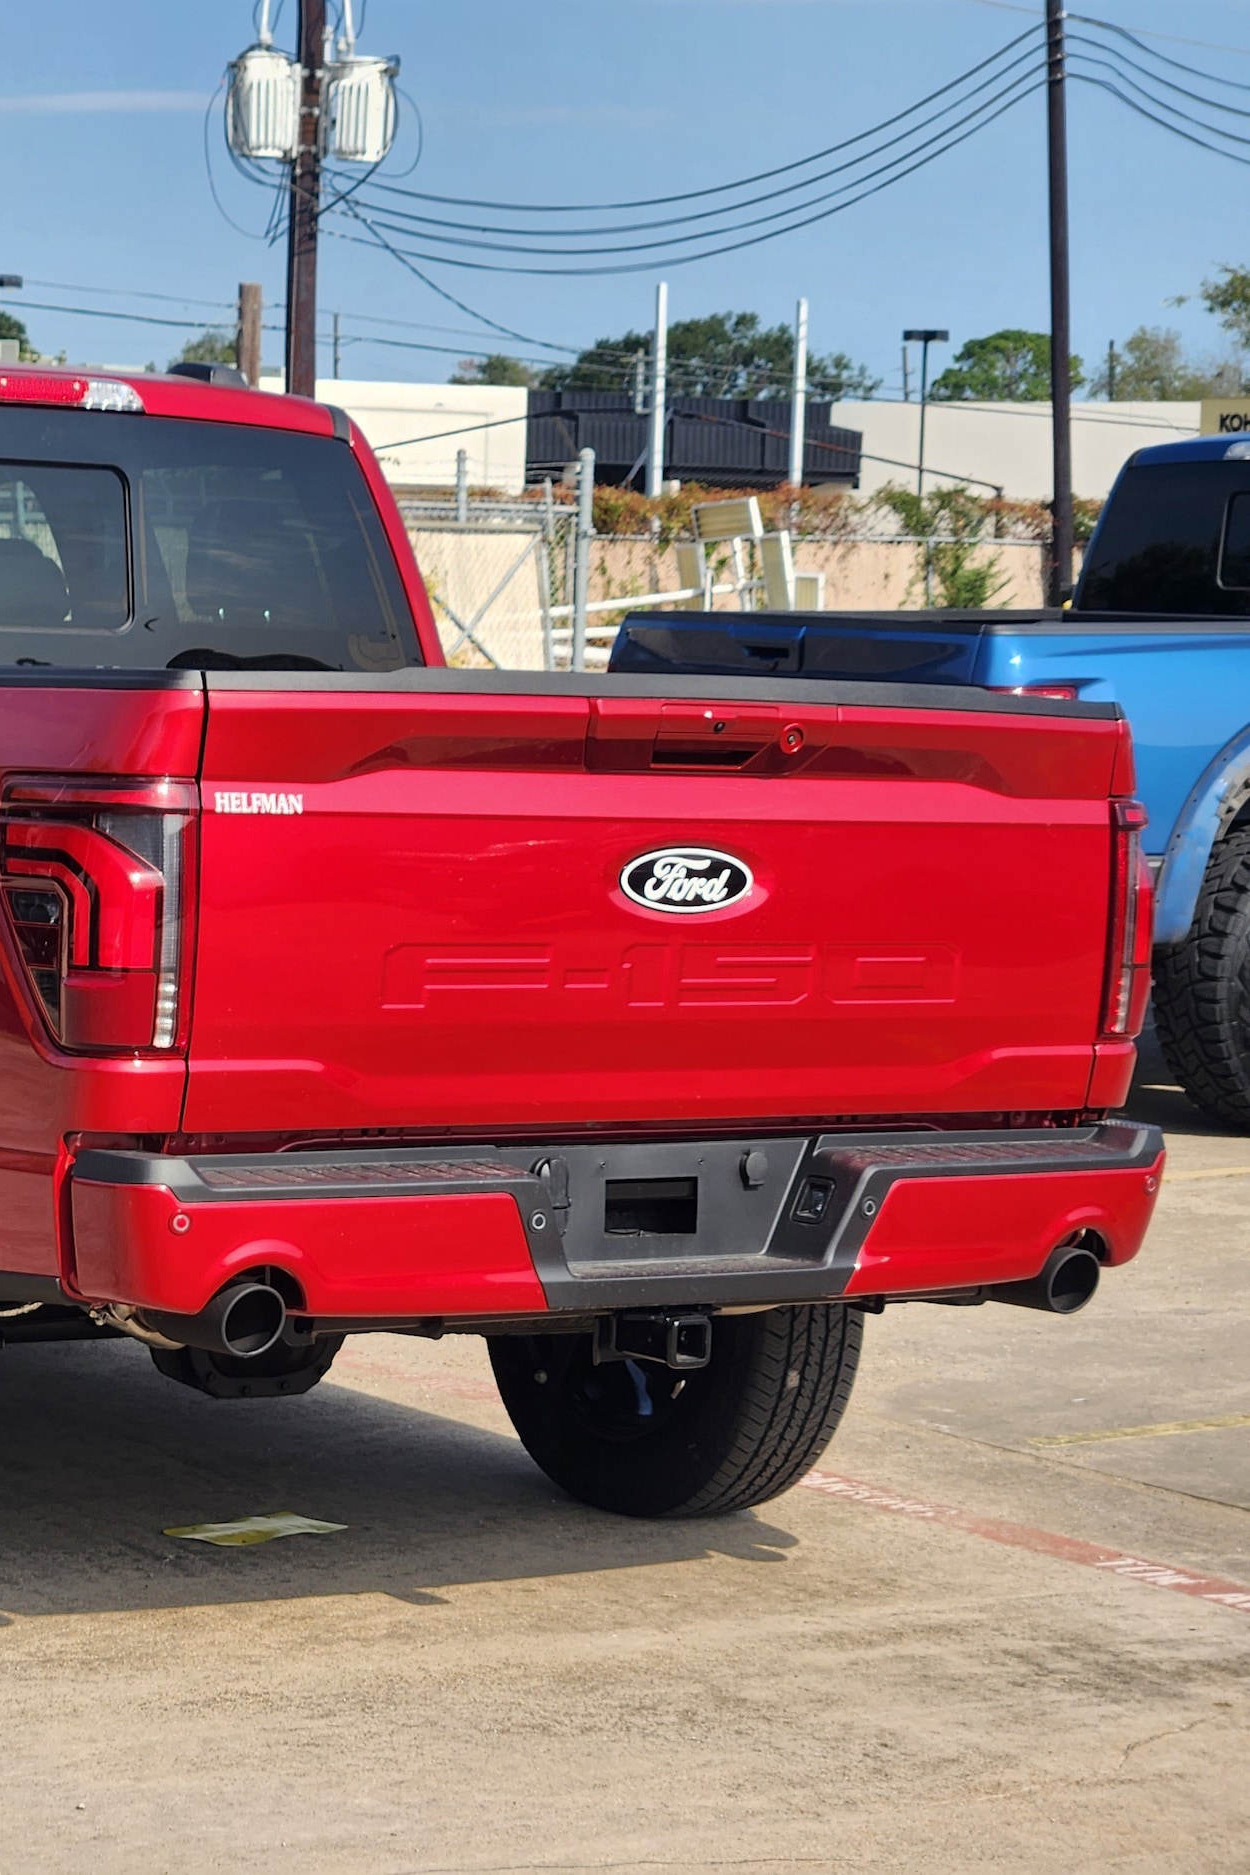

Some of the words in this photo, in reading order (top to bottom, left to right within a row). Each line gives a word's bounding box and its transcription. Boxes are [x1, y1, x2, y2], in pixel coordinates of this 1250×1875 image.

[214, 792, 303, 815] HELFMAN
[644, 856, 731, 902] Ford
[380, 941, 961, 1010] F-150
